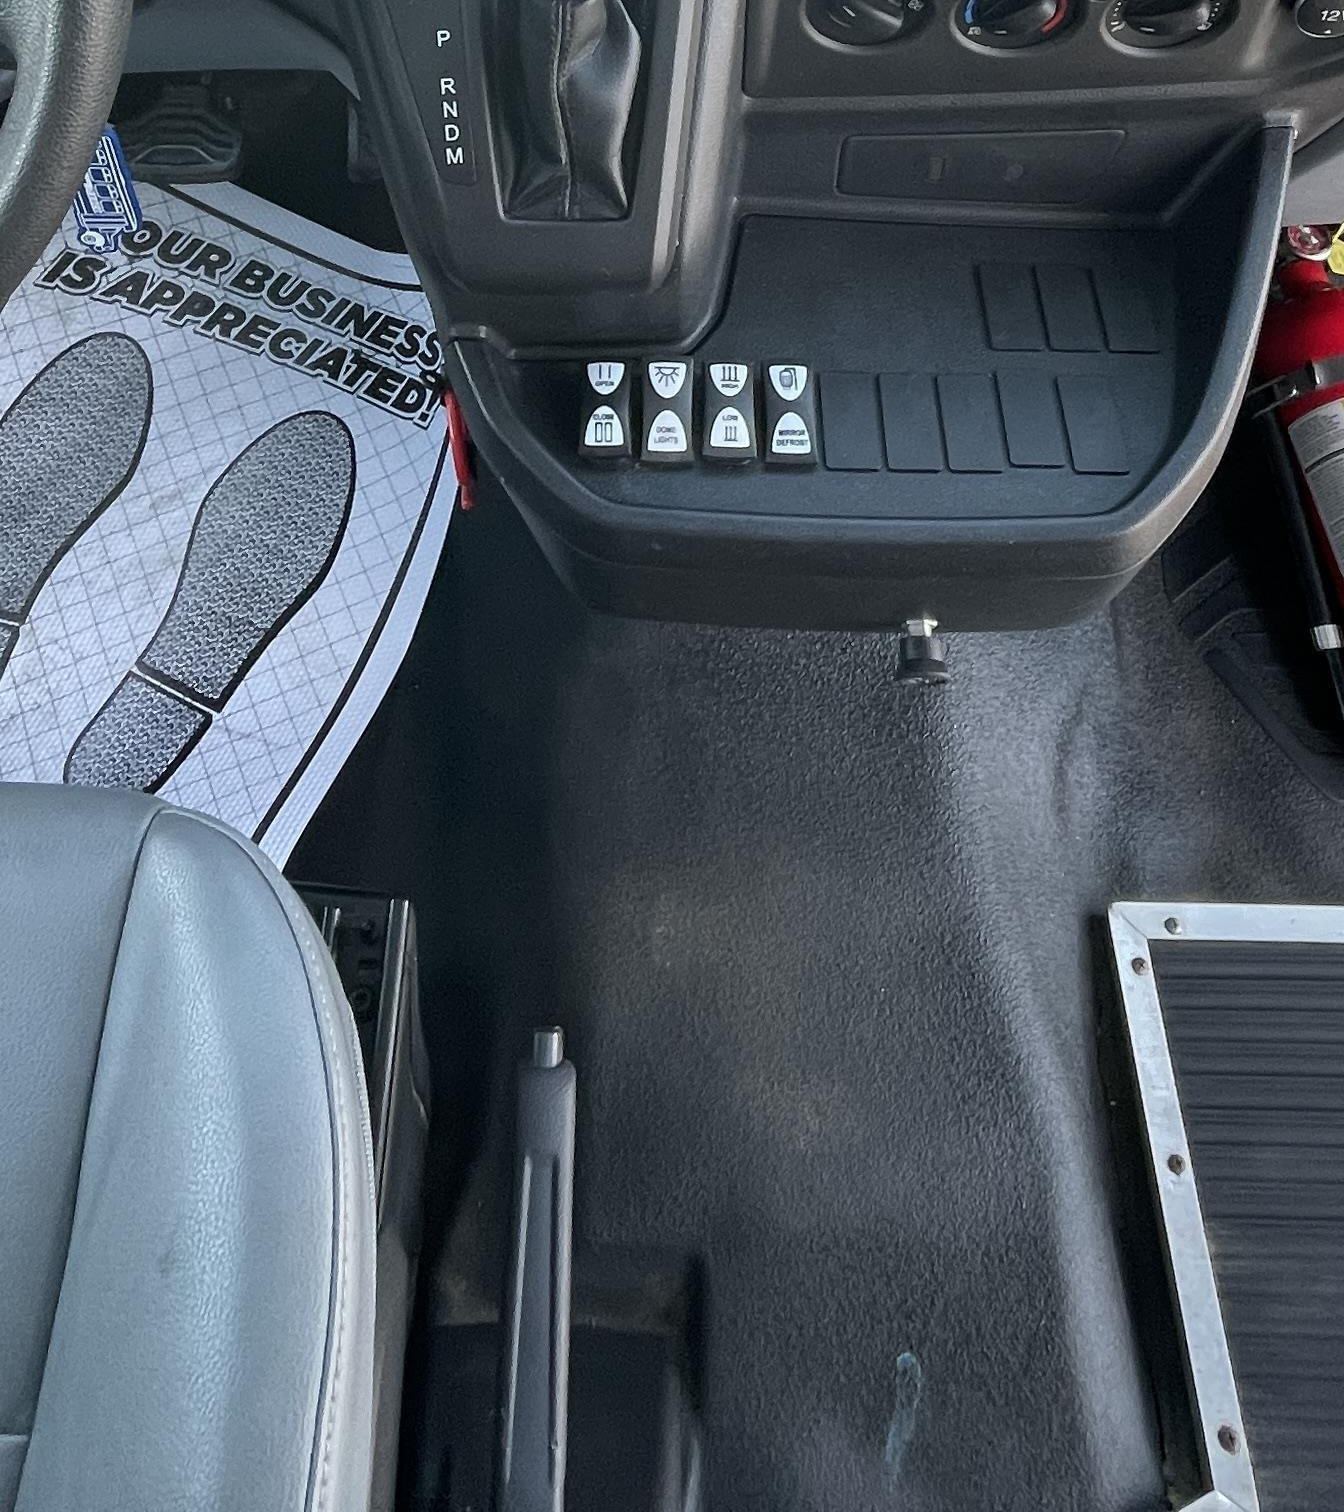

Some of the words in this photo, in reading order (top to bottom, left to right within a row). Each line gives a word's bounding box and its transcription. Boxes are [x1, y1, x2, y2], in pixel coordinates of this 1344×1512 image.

[436, 30, 451, 47] P
[440, 78, 457, 95] R
[442, 101, 458, 118] N
[444, 124, 460, 142] D
[446, 147, 464, 165] M
[117, 220, 233, 284] OUR
[229, 258, 444, 371] BUSINESS
[37, 250, 108, 294] IS
[99, 270, 442, 427] APPRECIATED!
